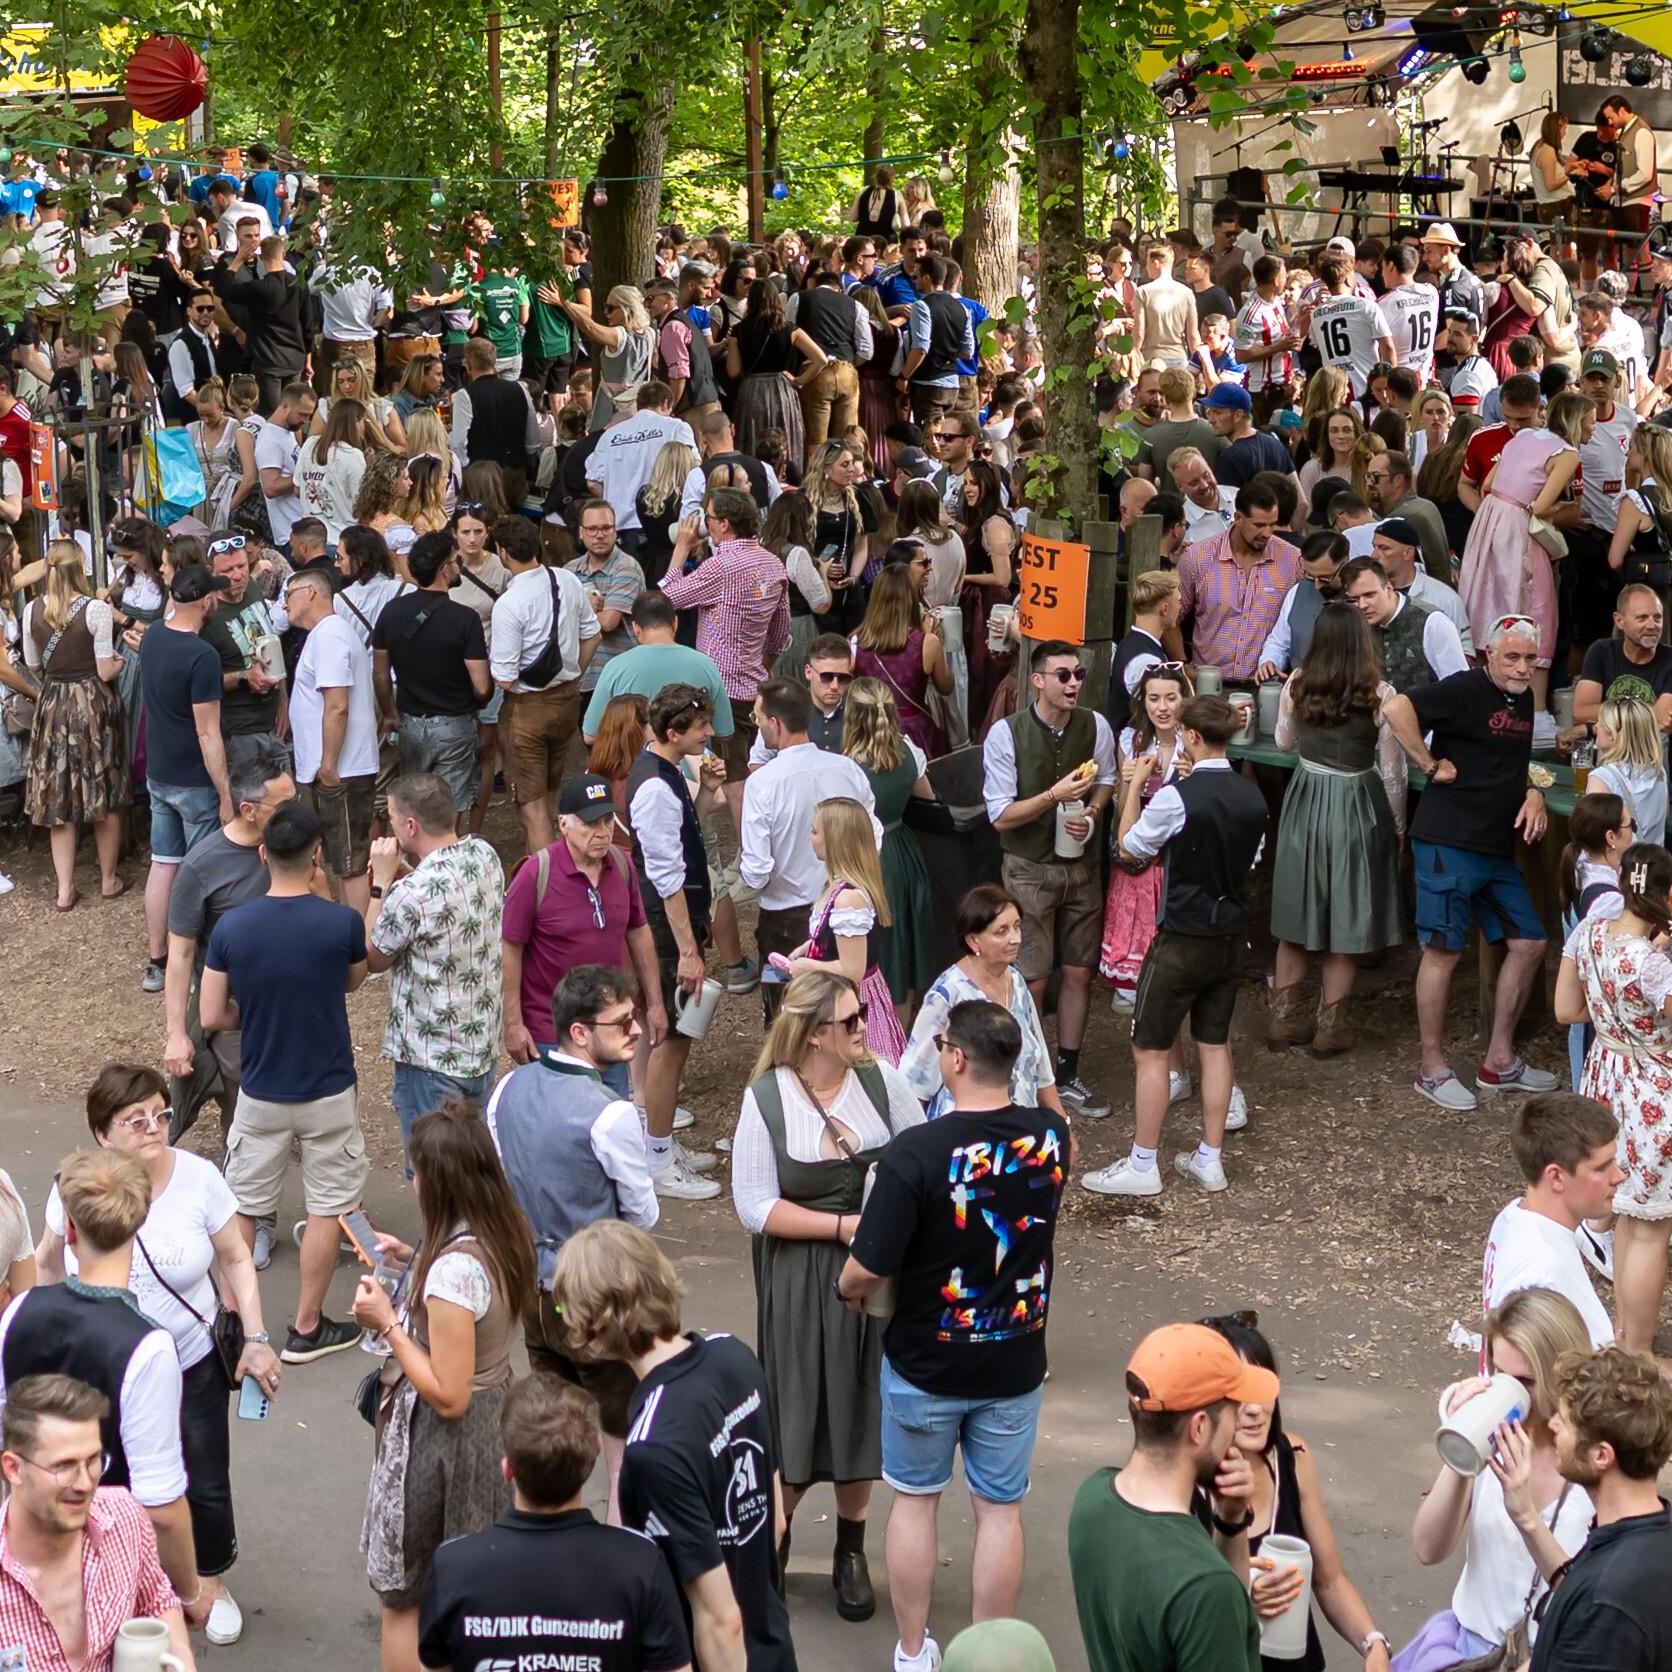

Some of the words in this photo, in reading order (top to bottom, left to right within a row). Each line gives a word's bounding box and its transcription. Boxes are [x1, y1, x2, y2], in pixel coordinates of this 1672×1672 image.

[1320, 317, 1352, 360] 16
[1408, 310, 1432, 353] 16
[1030, 582, 1059, 609] 25
[948, 1128, 1061, 1184] IBIZA
[464, 1615, 529, 1638] FSG/DJK
[531, 1615, 624, 1640] Gunzendorf
[518, 1654, 602, 1672] KRAMER
